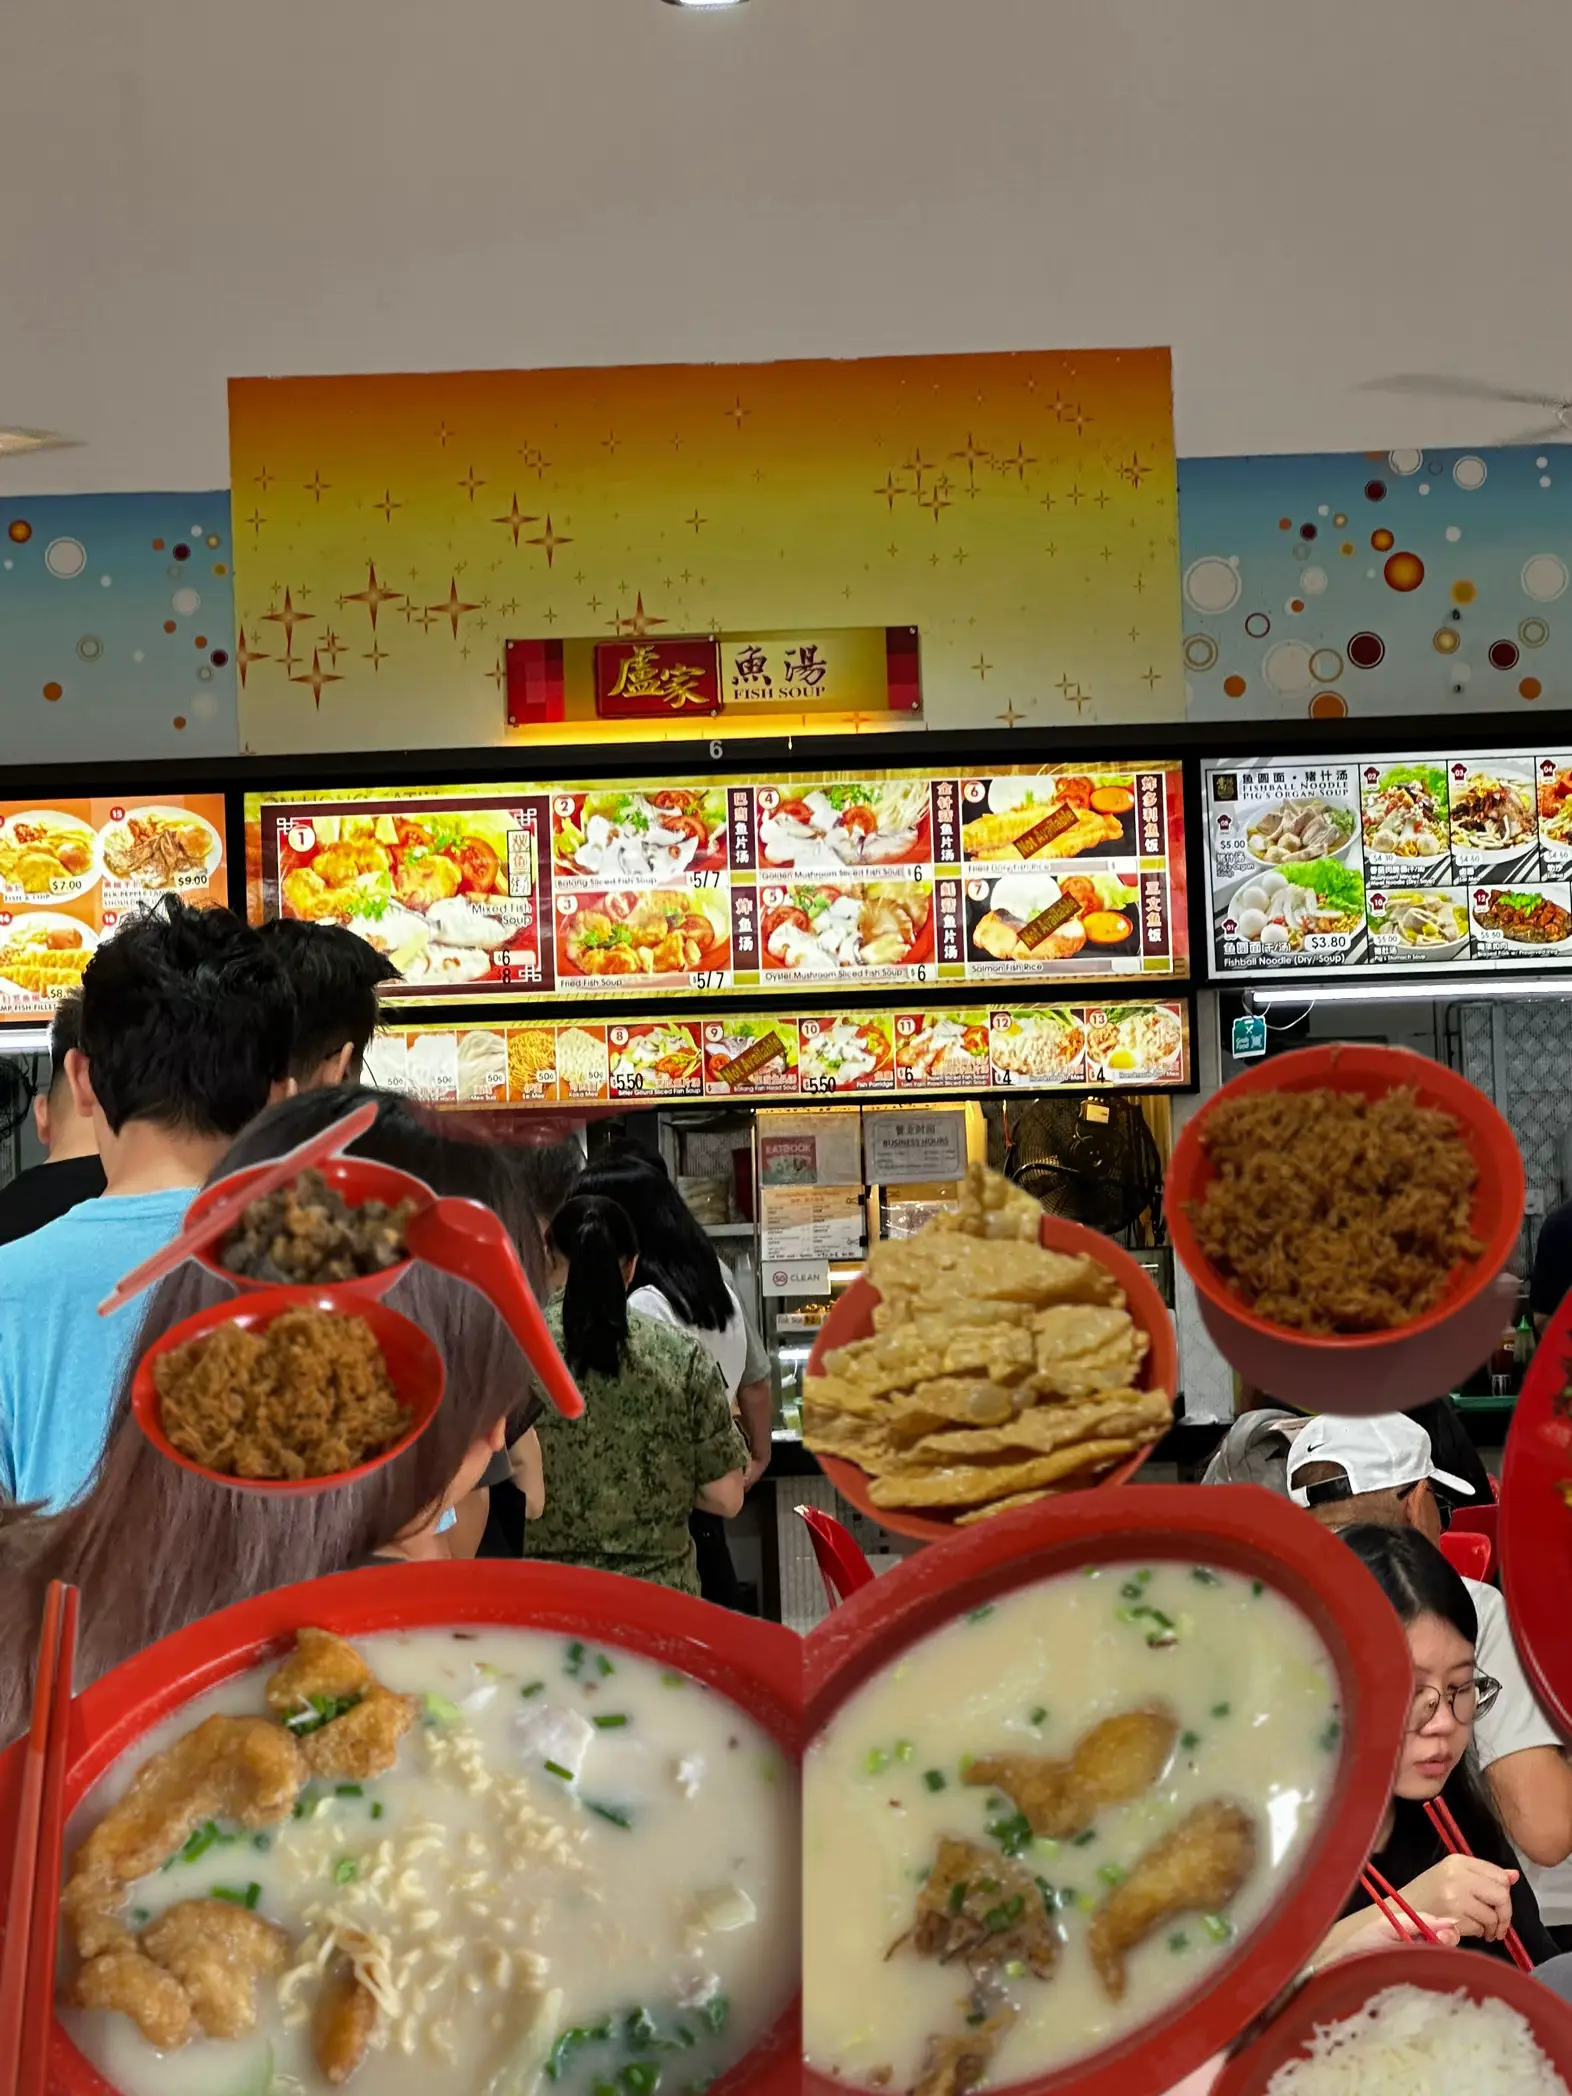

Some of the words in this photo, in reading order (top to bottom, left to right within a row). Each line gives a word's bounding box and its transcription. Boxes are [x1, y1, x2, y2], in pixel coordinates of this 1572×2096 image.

[607, 644, 710, 709] 盧家
[731, 644, 828, 686] 魚湯
[734, 687, 774, 700] FISH
[778, 686, 826, 699] SOUP
[709, 740, 723, 759] 6
[1455, 769, 1464, 777] 03
[970, 785, 979, 798] 6
[1243, 783, 1296, 792] FISHBALL
[1300, 782, 1348, 790] NOODLE
[764, 793, 773, 804] 4
[1275, 790, 1316, 799] ORGAN
[1320, 788, 1348, 797] SOUP
[560, 800, 569, 812] 2
[1015, 837, 1038, 855] Not
[1034, 810, 1075, 844] Available
[298, 831, 305, 846] 1
[1220, 840, 1246, 849] $5.00
[52, 880, 82, 890] $7.00
[178, 875, 208, 886] $9.00
[975, 884, 983, 896] 7
[769, 891, 778, 902] 5
[472, 903, 507, 914] Mixed
[510, 903, 532, 913] Fish
[503, 915, 532, 927] Soup
[735, 897, 754, 952] 炸鱼汤
[1020, 927, 1042, 946] Not
[1037, 898, 1078, 934] Available
[1311, 936, 1346, 949] $3.80
[1224, 956, 1256, 966] Fishball
[1259, 955, 1292, 965] Noodle
[972, 965, 1003, 973] Salmon
[1005, 964, 1021, 972] Fish
[1024, 963, 1042, 971] Rice
[502, 967, 511, 984] 8
[765, 971, 791, 982] Oyster
[793, 970, 837, 979] Mushroom
[839, 969, 864, 978] Sliced
[865, 968, 880, 976] Fish
[882, 967, 903, 977] Soup
[561, 979, 581, 988] Fried
[583, 979, 599, 987] Fish
[601, 978, 623, 988] Soup
[14, 1003, 32, 1011] FISH
[996, 1017, 1009, 1027] 12
[1092, 1014, 1106, 1024] 13
[804, 1024, 818, 1034] 10
[900, 1021, 912, 1031] 11
[616, 1031, 623, 1041] 8
[711, 1028, 718, 1038] 9
[722, 1063, 744, 1084] Not
[740, 1038, 782, 1073] Available
[883, 1139, 919, 1148] BUSINESS
[922, 1137, 949, 1146] HOURS
[766, 1144, 811, 1154] EATBOOK
